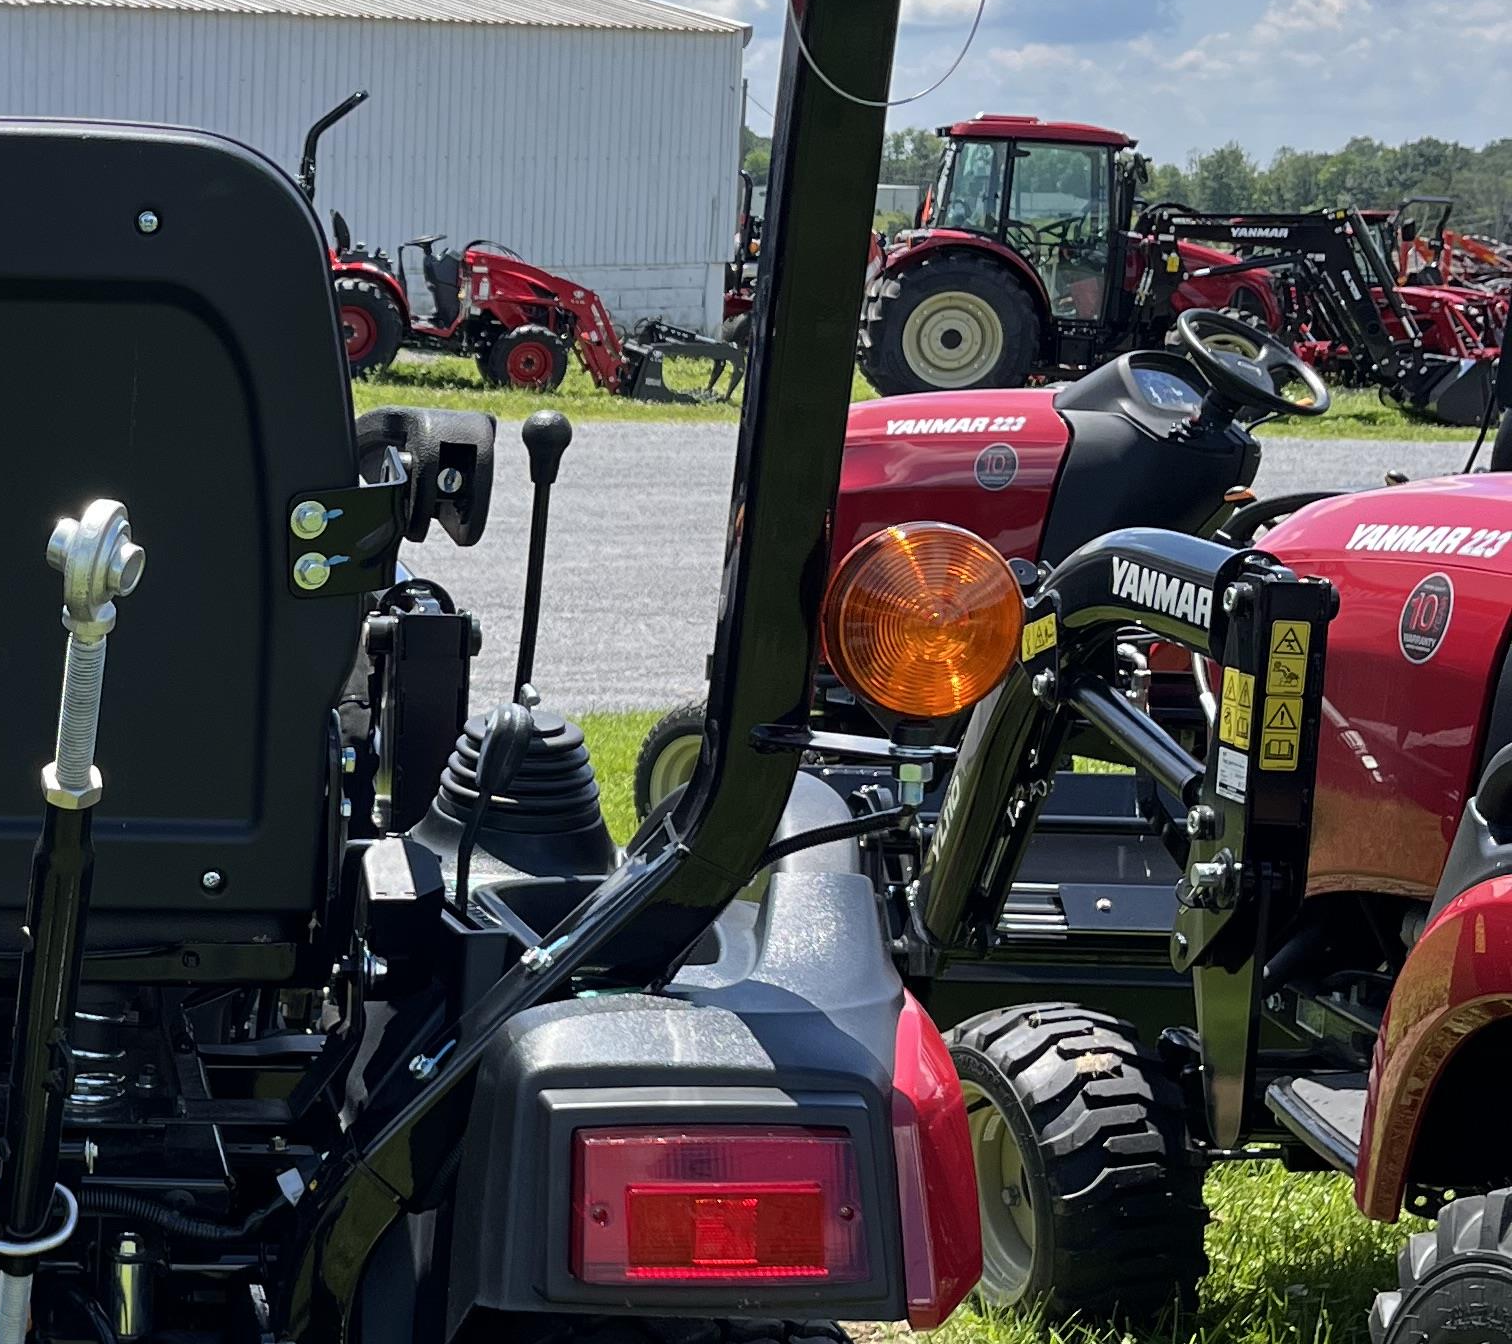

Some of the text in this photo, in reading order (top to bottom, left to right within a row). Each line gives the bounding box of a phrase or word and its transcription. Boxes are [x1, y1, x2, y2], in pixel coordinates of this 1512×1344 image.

[1231, 227, 1288, 238] YANMAR
[886, 416, 1026, 435] YANMAR 223
[1345, 523, 1512, 558] YANMAR 223
[1112, 556, 1213, 629] YANMAR
[1409, 592, 1439, 631] 10
